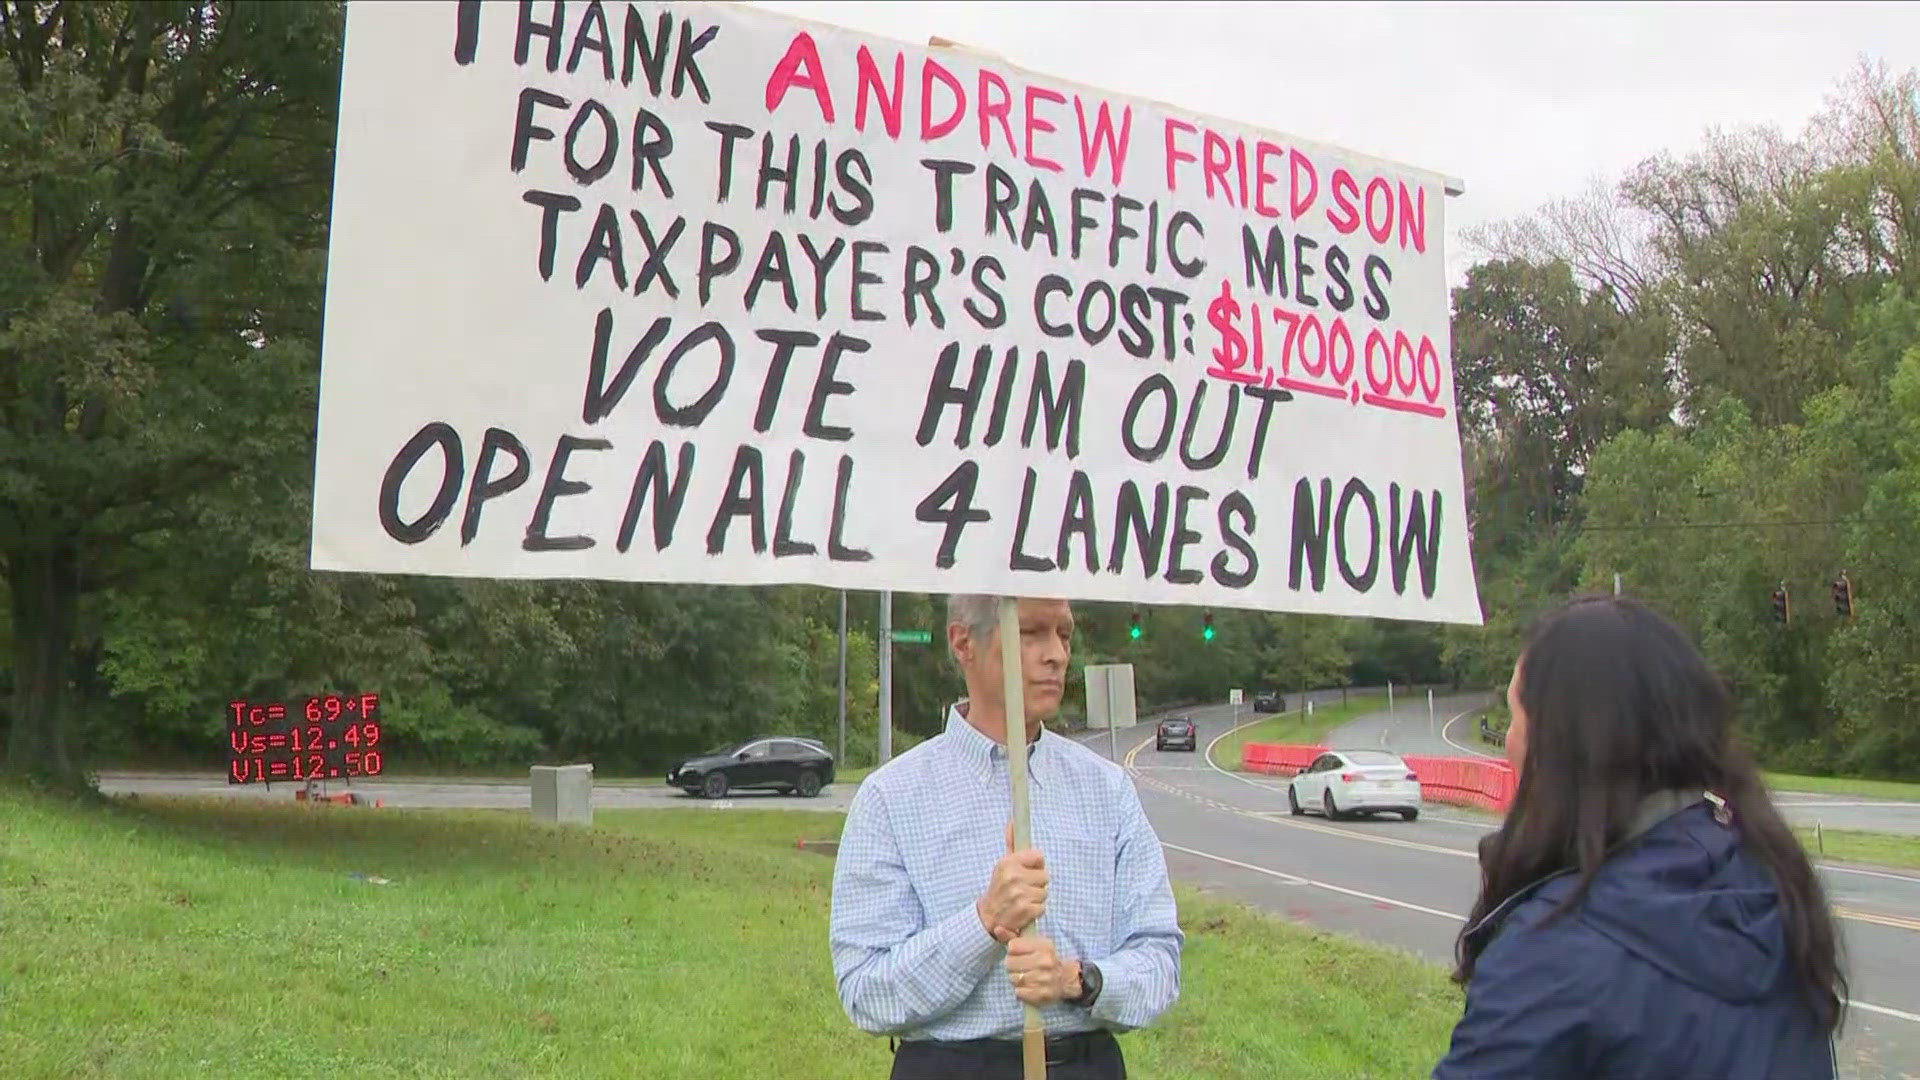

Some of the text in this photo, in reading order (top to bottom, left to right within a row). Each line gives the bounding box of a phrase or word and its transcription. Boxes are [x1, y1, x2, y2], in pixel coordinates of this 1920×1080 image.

[510, 86, 1393, 322] FOR THIS TRAFFIC MESS
[766, 30, 1132, 188] ANDREW
[1164, 118, 1427, 256] FRIEDSON
[522, 190, 1444, 408] TAXPAYER'S COST: $1,700,000
[582, 308, 1294, 480] VOTE HIM OUT
[379, 421, 1442, 599] OPEN ALL 4 LANES NOW
[230, 701, 286, 726] Tc=
